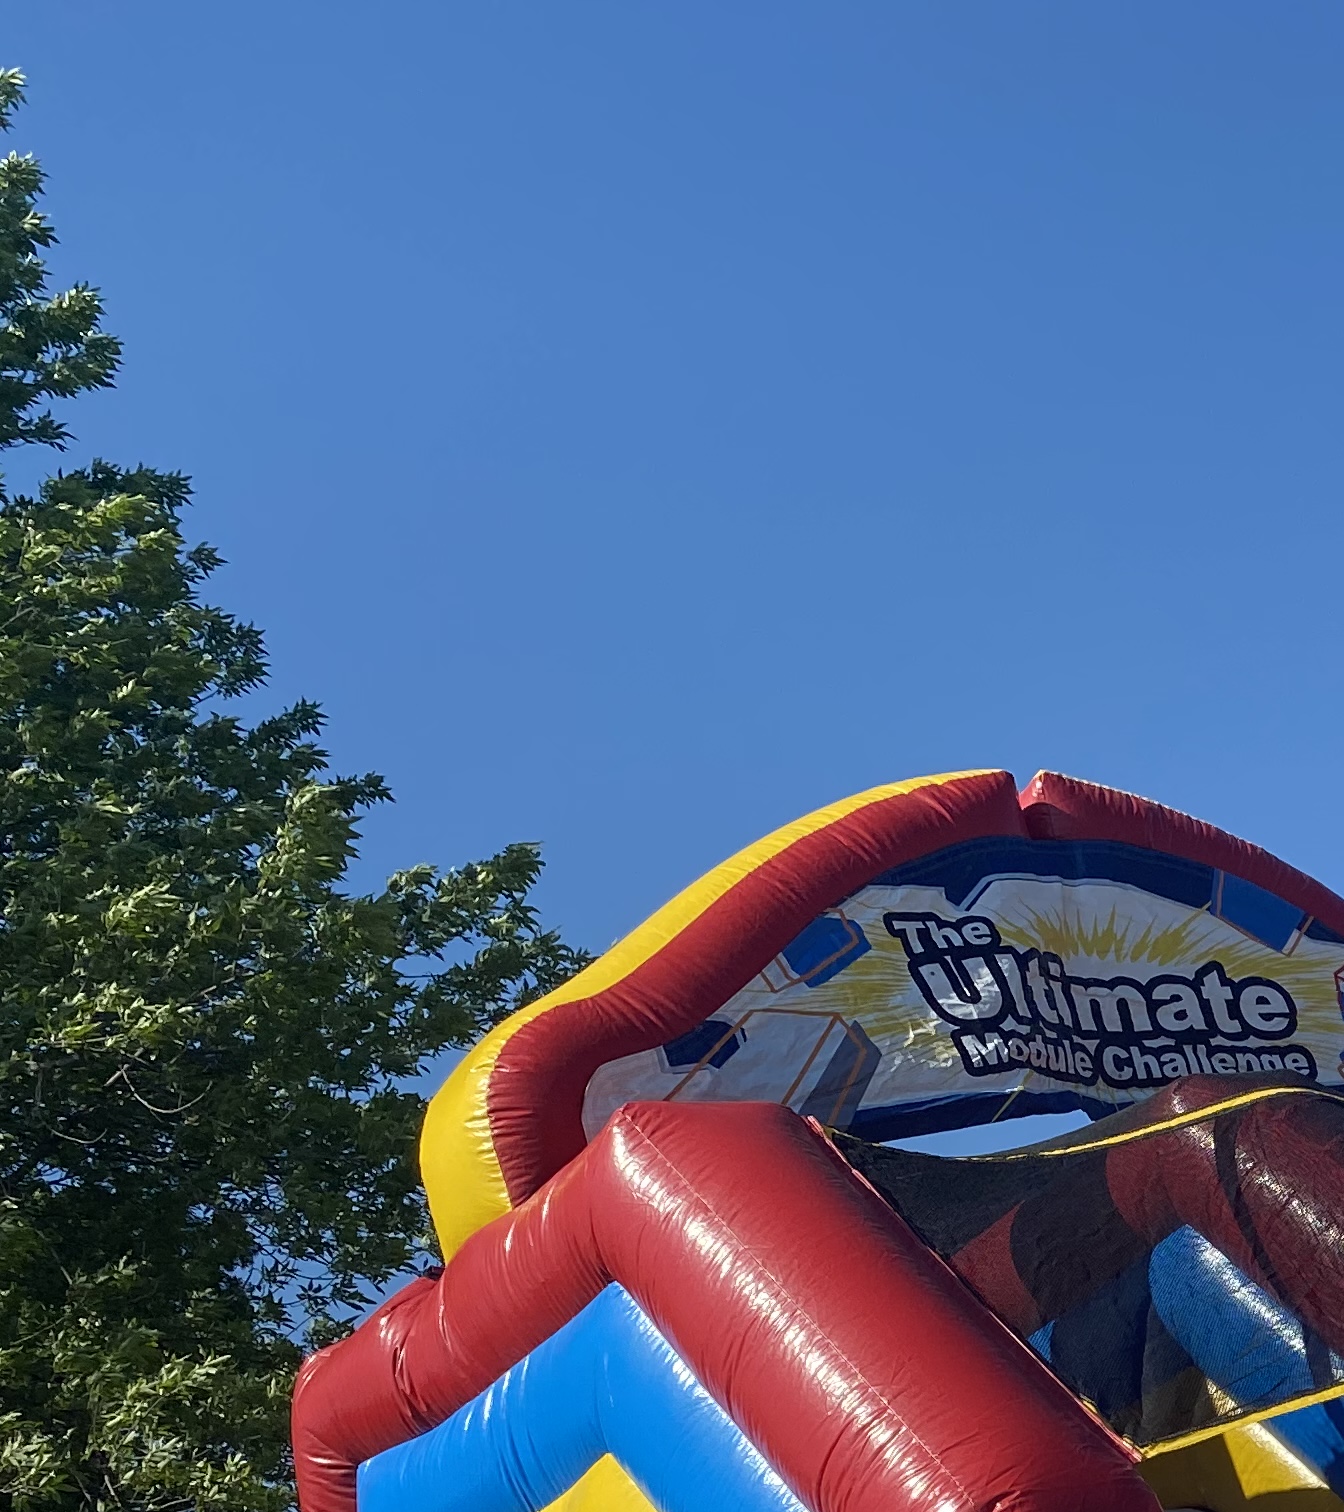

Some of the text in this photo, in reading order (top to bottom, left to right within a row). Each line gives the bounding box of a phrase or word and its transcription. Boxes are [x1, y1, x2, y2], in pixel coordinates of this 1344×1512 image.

[892, 919, 992, 954] The
[919, 952, 1292, 1034] Ultimate
[961, 1033, 1310, 1081] Module Challenge
